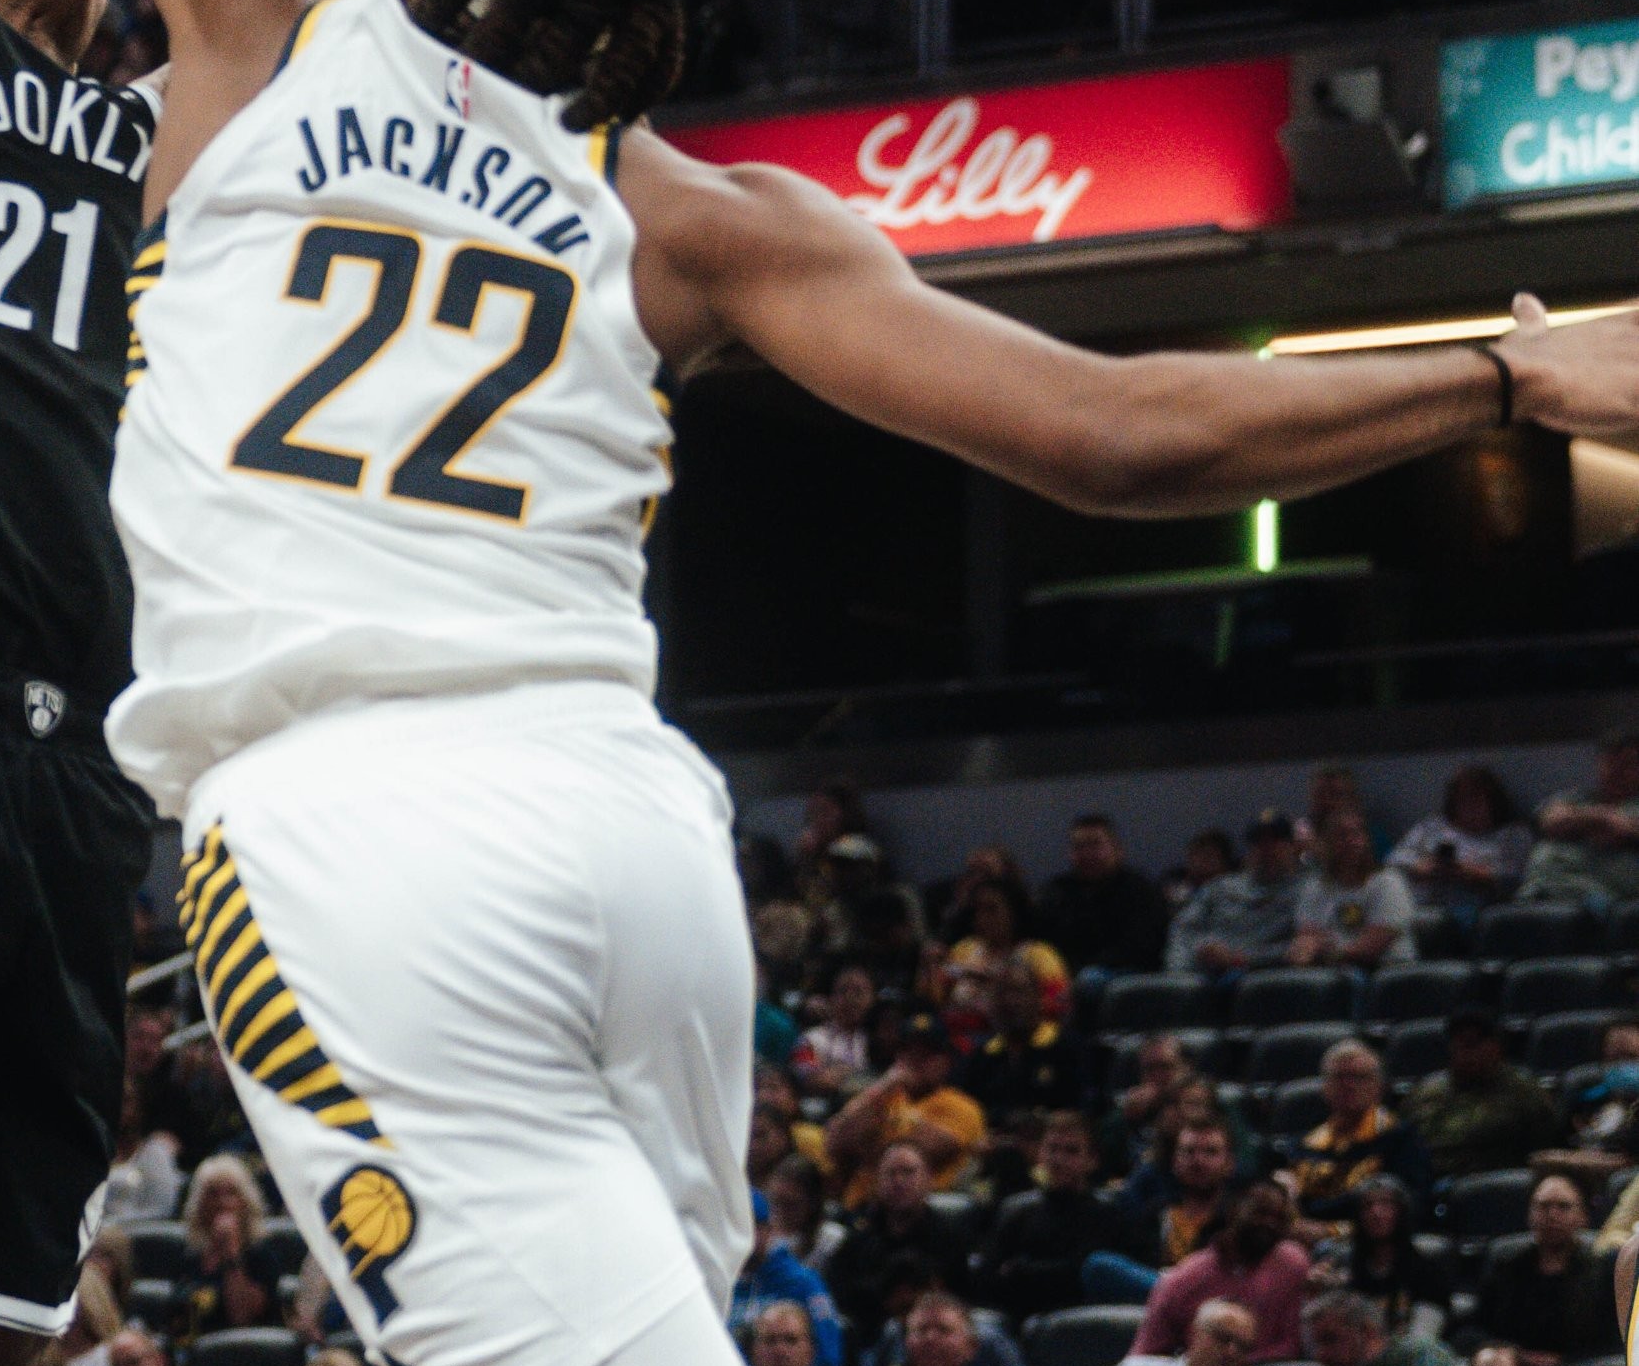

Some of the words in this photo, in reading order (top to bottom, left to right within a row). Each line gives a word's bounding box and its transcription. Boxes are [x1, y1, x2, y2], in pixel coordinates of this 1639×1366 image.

[296, 106, 593, 256] JACKSON
[845, 96, 1094, 242] Lilly
[225, 216, 581, 530] 22
